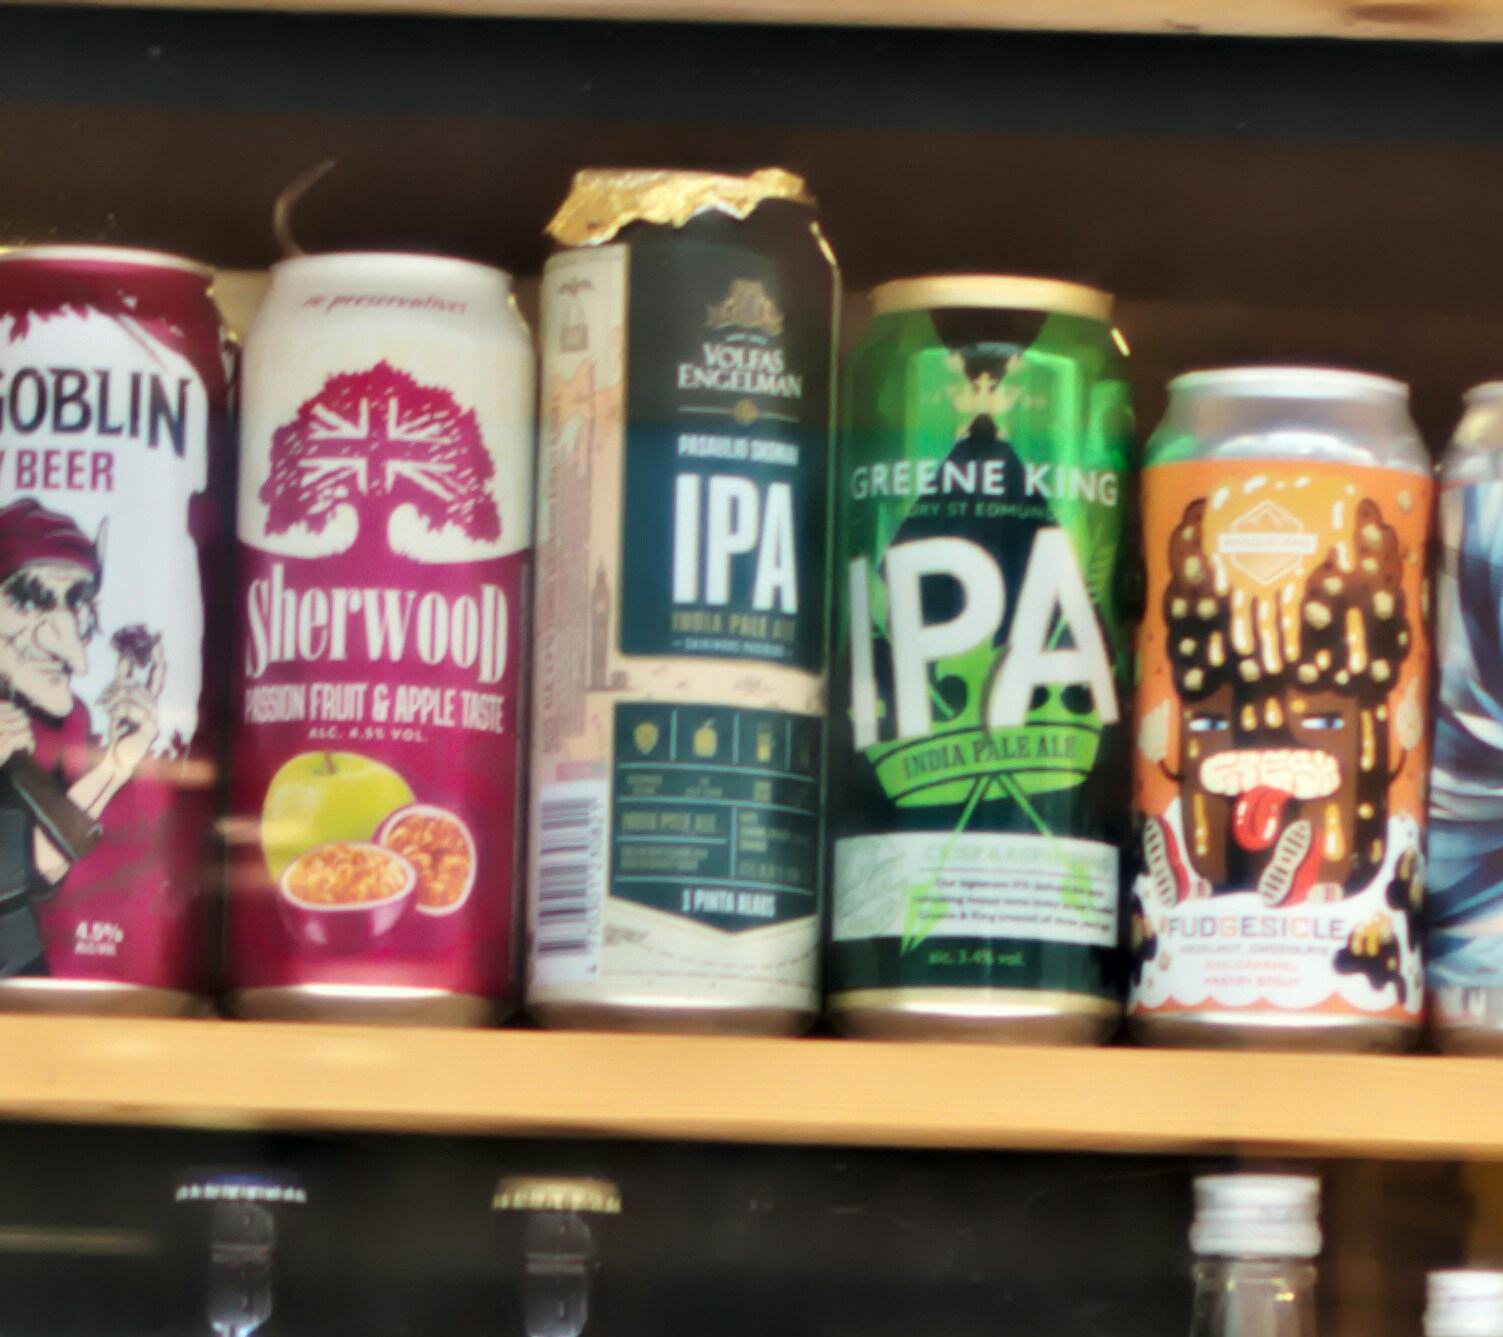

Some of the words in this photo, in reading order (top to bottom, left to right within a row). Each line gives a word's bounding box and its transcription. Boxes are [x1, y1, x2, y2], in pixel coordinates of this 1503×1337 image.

[677, 362, 803, 399] ENGELMAN
[702, 343, 785, 376] VOLFAS
[15, 449, 115, 493] BEER
[852, 458, 1005, 502] GREENE
[1024, 461, 1122, 507] KING
[672, 472, 800, 615] IPA
[848, 524, 1122, 756] IPA
[244, 683, 305, 727] PASSION
[308, 684, 366, 723] FRUIT
[394, 686, 456, 729] APPLE
[459, 691, 505, 735] TASTE
[902, 744, 967, 781] INDIA
[971, 738, 1030, 774] PALE
[1036, 732, 1080, 764] ALE
[1167, 914, 1347, 941] FUDGESICLE
